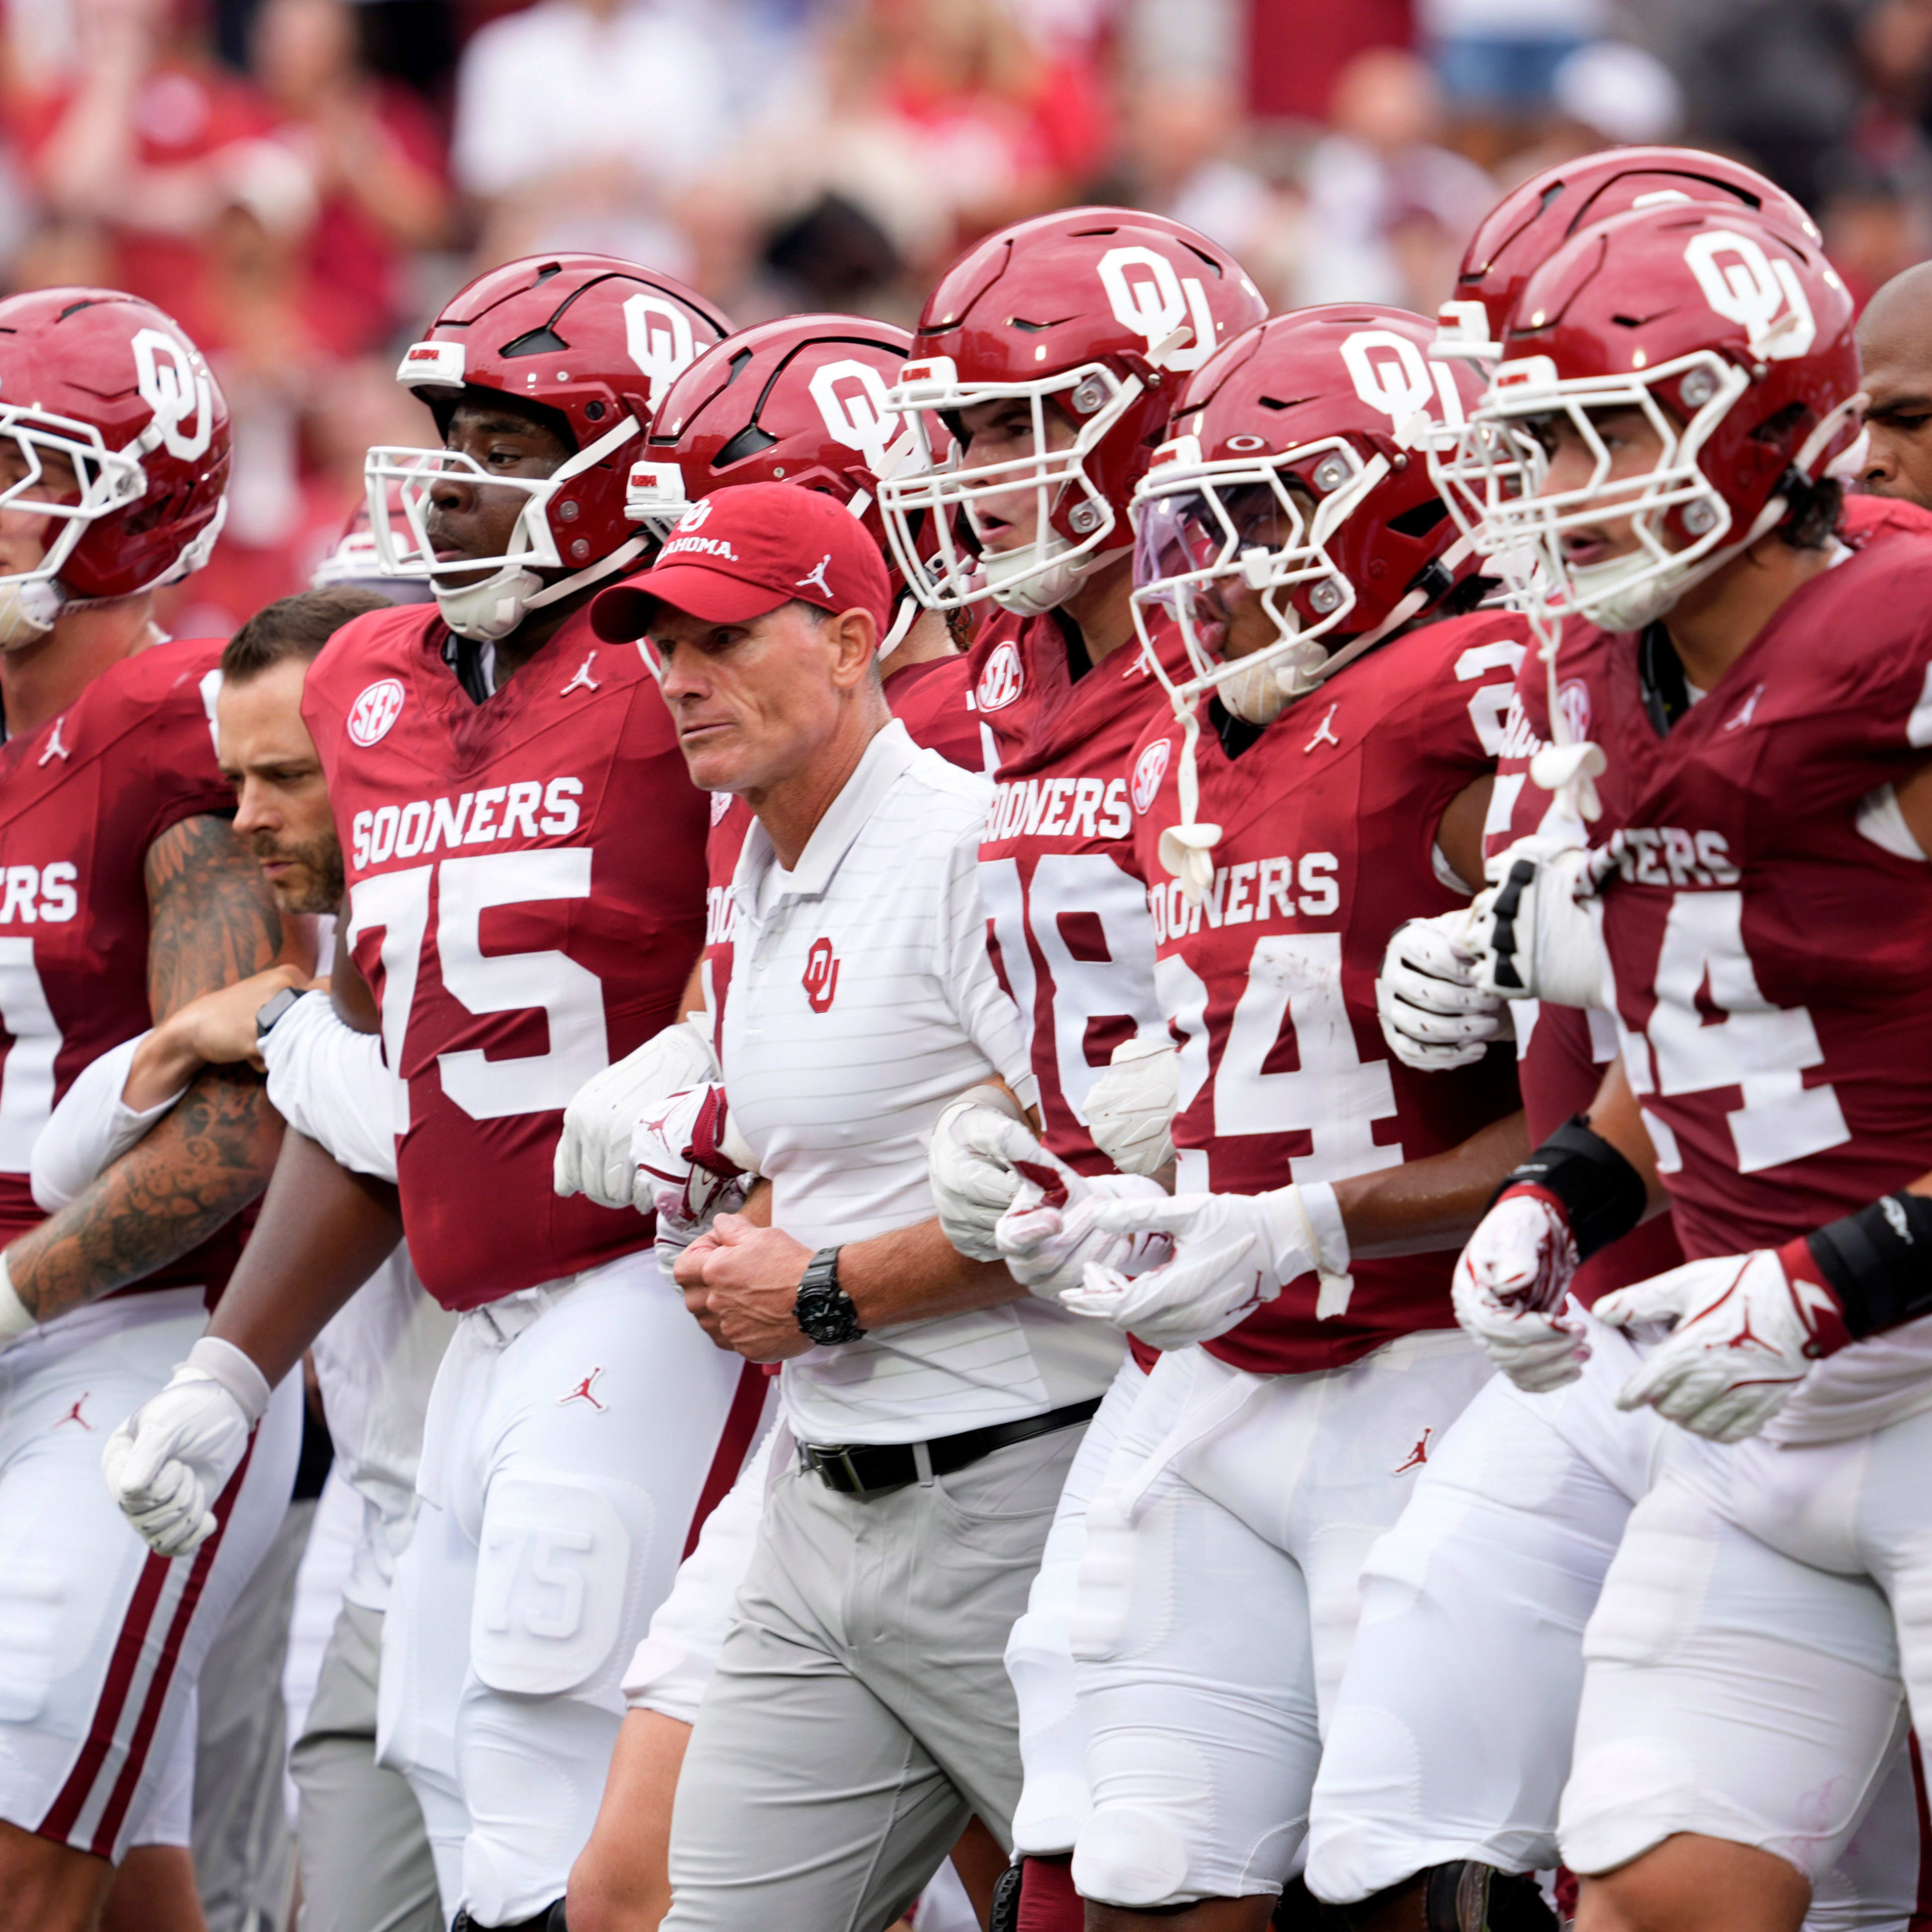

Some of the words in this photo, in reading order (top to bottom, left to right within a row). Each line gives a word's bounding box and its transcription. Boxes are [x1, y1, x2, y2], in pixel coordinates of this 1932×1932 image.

[1096, 246, 1217, 372] OU
[1684, 230, 1817, 361] OU
[131, 328, 212, 462] OU
[351, 683, 401, 742] SEC
[352, 776, 583, 871] SOONERS
[980, 778, 1132, 844] OONERS
[1148, 851, 1340, 946] OONERS
[347, 847, 609, 1137] 75
[802, 937, 840, 1013] OU
[489, 1523, 593, 1641] 75
